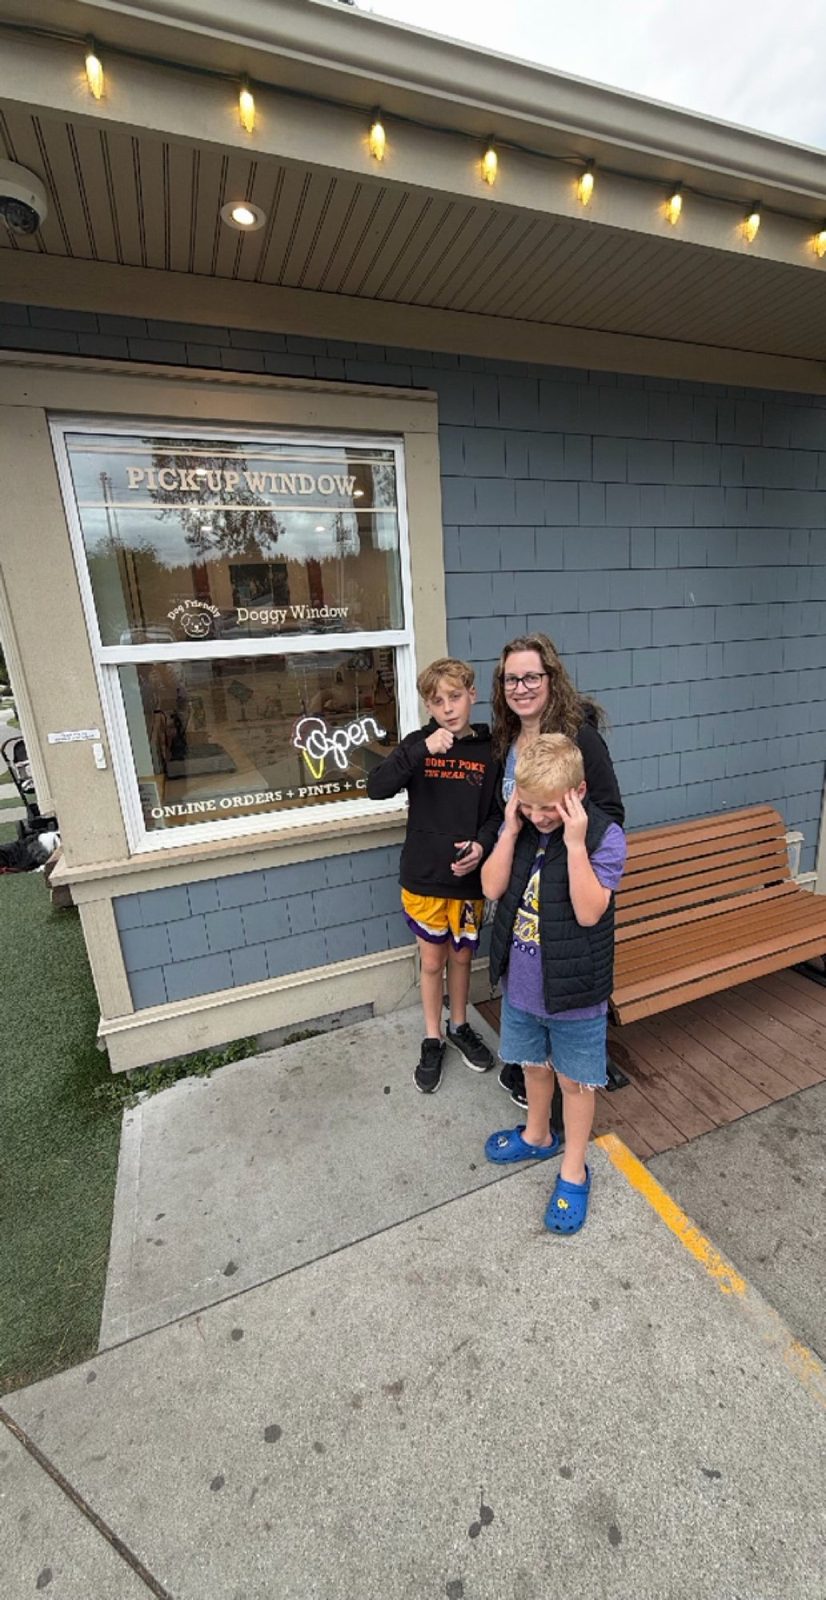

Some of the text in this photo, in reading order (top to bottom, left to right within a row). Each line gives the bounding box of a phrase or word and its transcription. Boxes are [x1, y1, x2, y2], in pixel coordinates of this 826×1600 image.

[126, 466, 357, 496] PICK-UP WINDOW
[167, 599, 221, 620] Dog Friendly
[236, 604, 349, 624] Doggy Window
[305, 717, 387, 769] Open
[424, 757, 486, 774] DON'T POKE
[151, 800, 217, 819] ONLINE
[219, 790, 282, 809] ORDERS
[298, 783, 340, 799] PINTS
